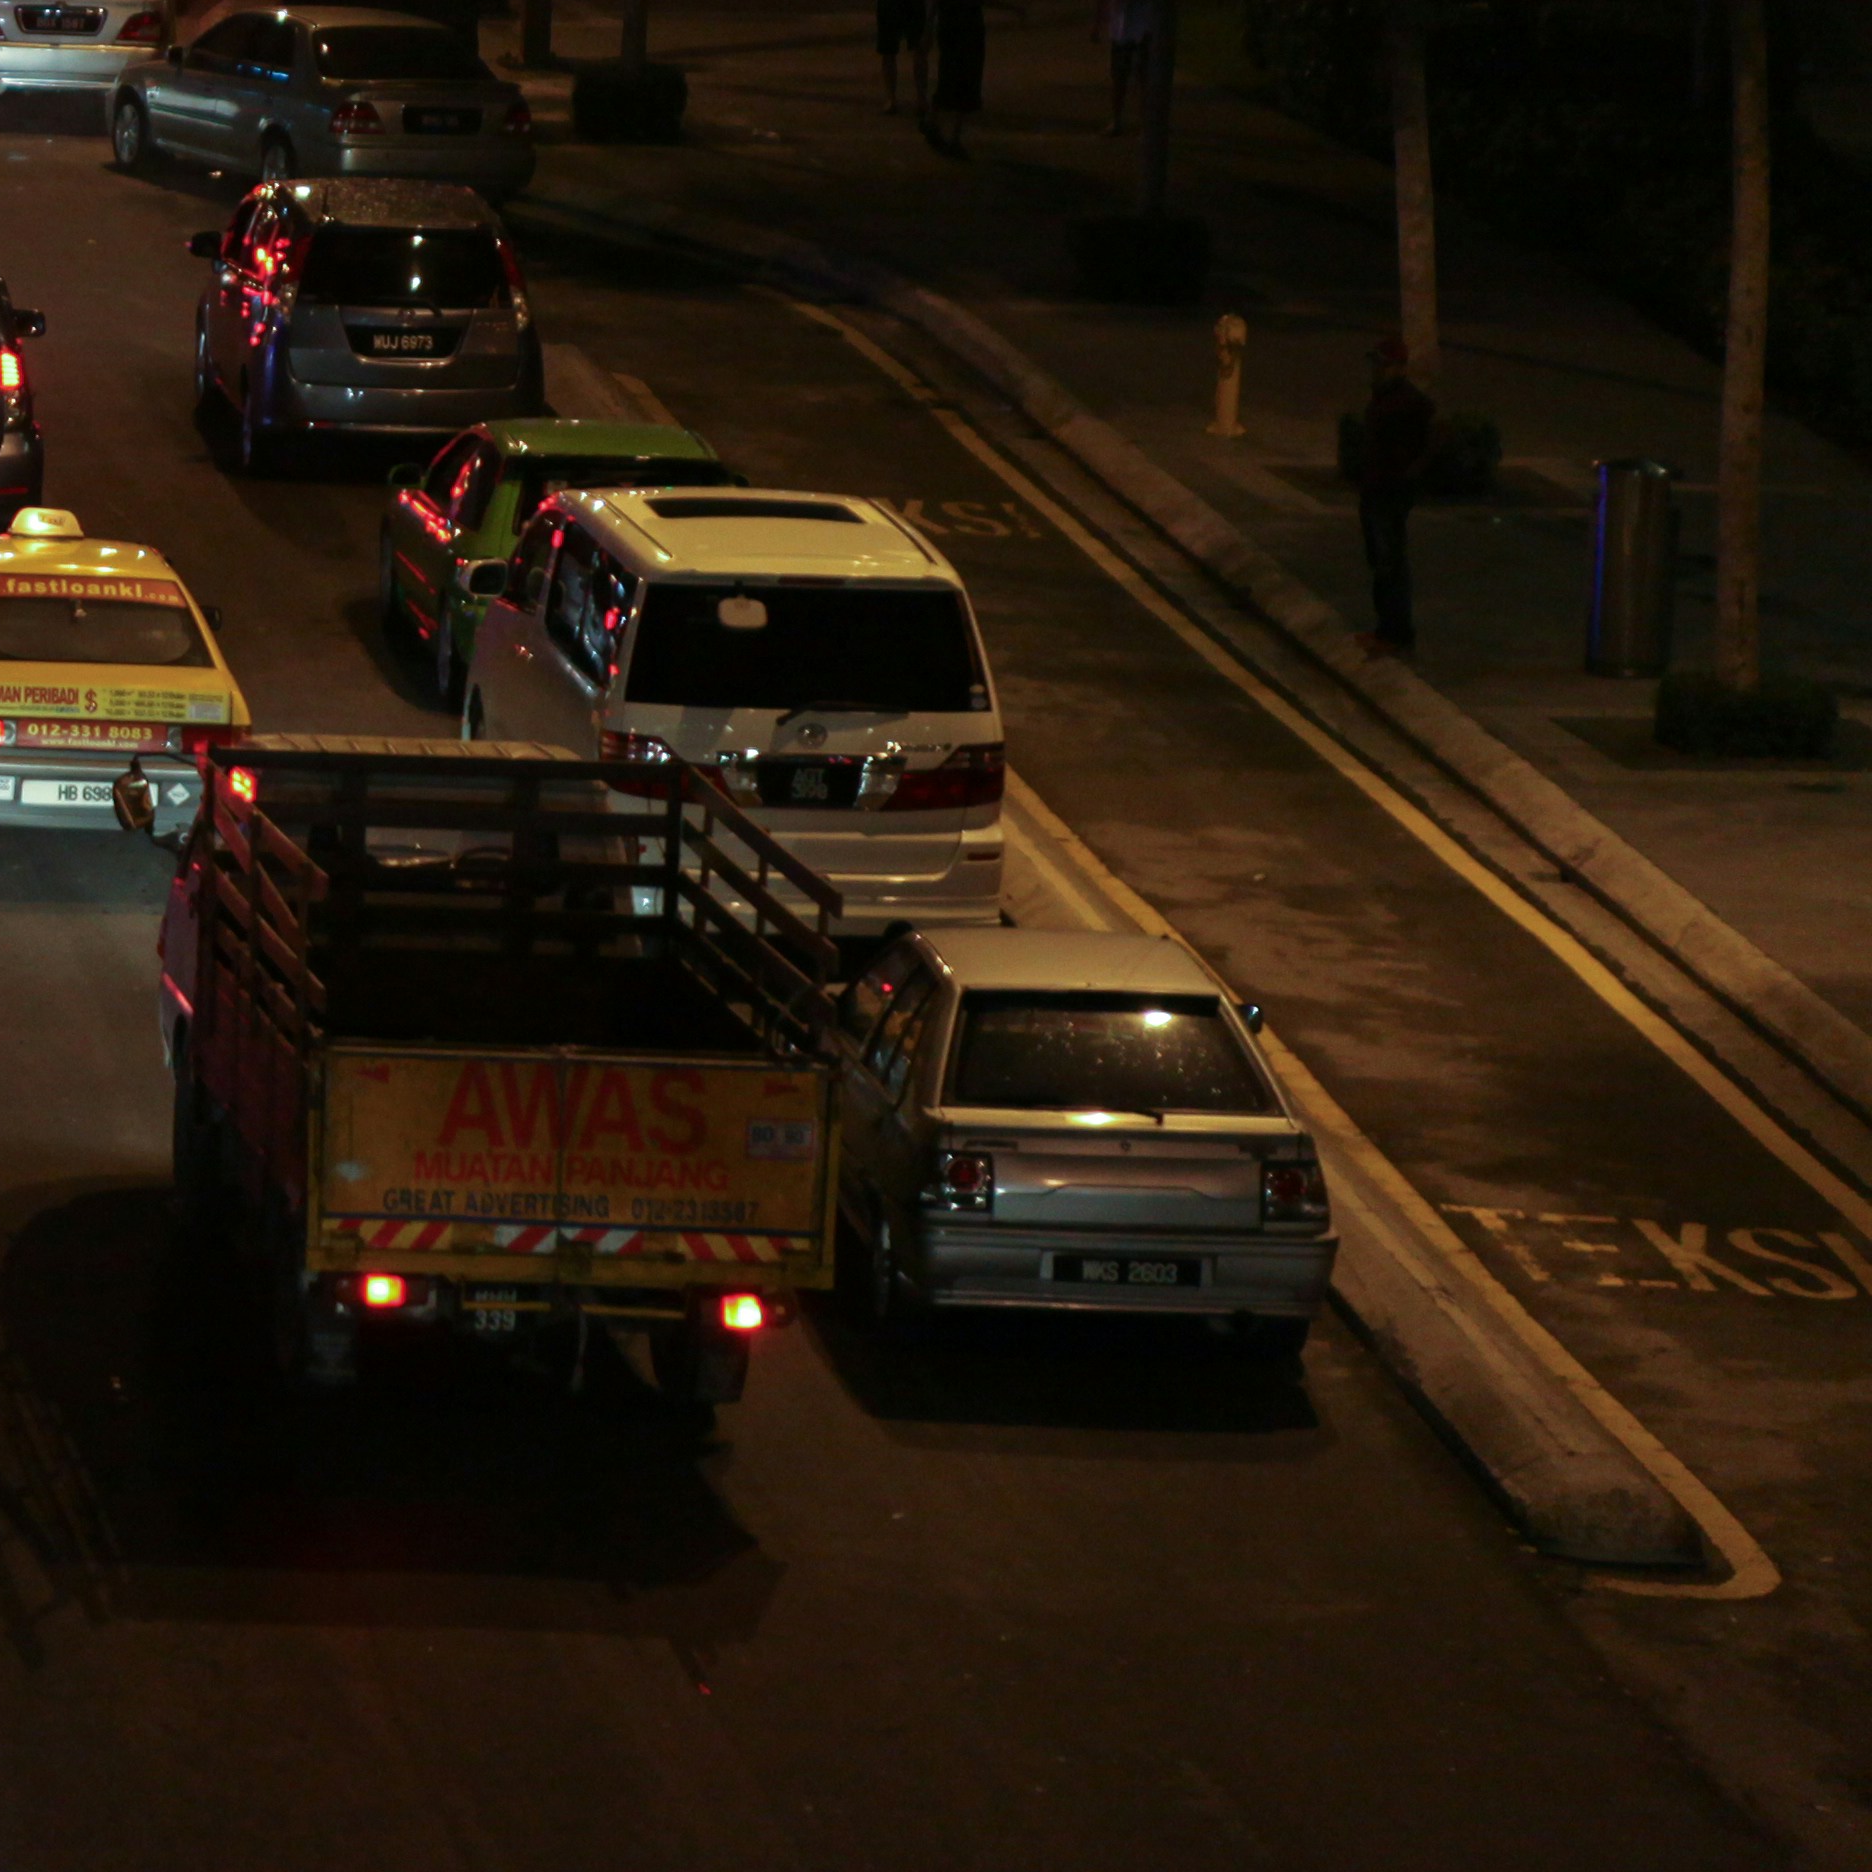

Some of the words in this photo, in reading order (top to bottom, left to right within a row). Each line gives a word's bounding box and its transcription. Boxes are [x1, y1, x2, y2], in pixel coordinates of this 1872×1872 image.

[23, 686, 80, 705] PERIBADI
[27, 722, 101, 739] 012-331
[108, 724, 153, 740] 8083
[57, 784, 79, 802] HB
[436, 1058, 710, 1156] AWAS
[414, 1150, 553, 1186] MUATAN
[565, 1152, 731, 1192] PANJANG
[382, 1187, 456, 1215] GREAT
[464, 1190, 610, 1219] ADVERTISING
